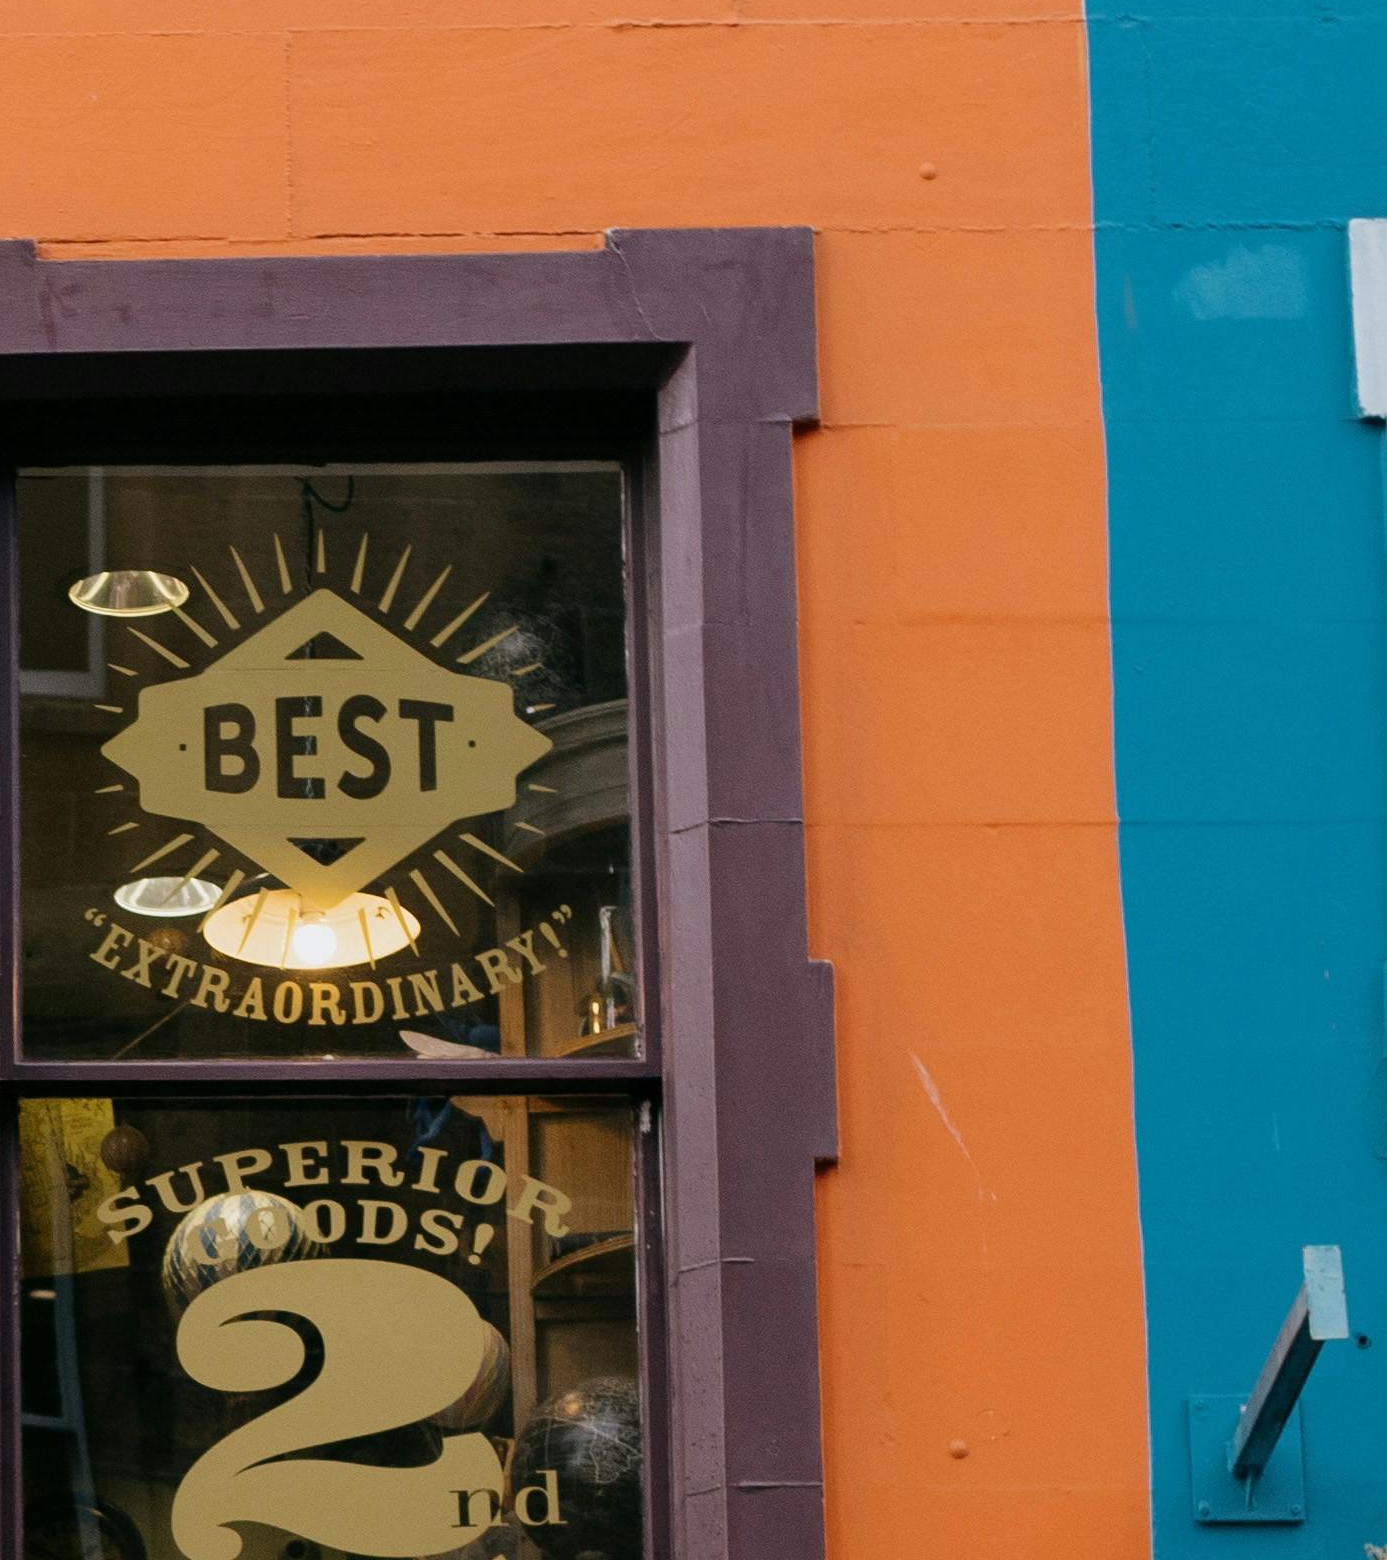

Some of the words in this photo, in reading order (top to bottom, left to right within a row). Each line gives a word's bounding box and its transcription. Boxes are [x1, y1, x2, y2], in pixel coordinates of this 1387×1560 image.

[203, 694, 454, 800] BEST
[96, 1140, 573, 1244] SUPERIOR
[187, 1199, 494, 1266] GOODS!
